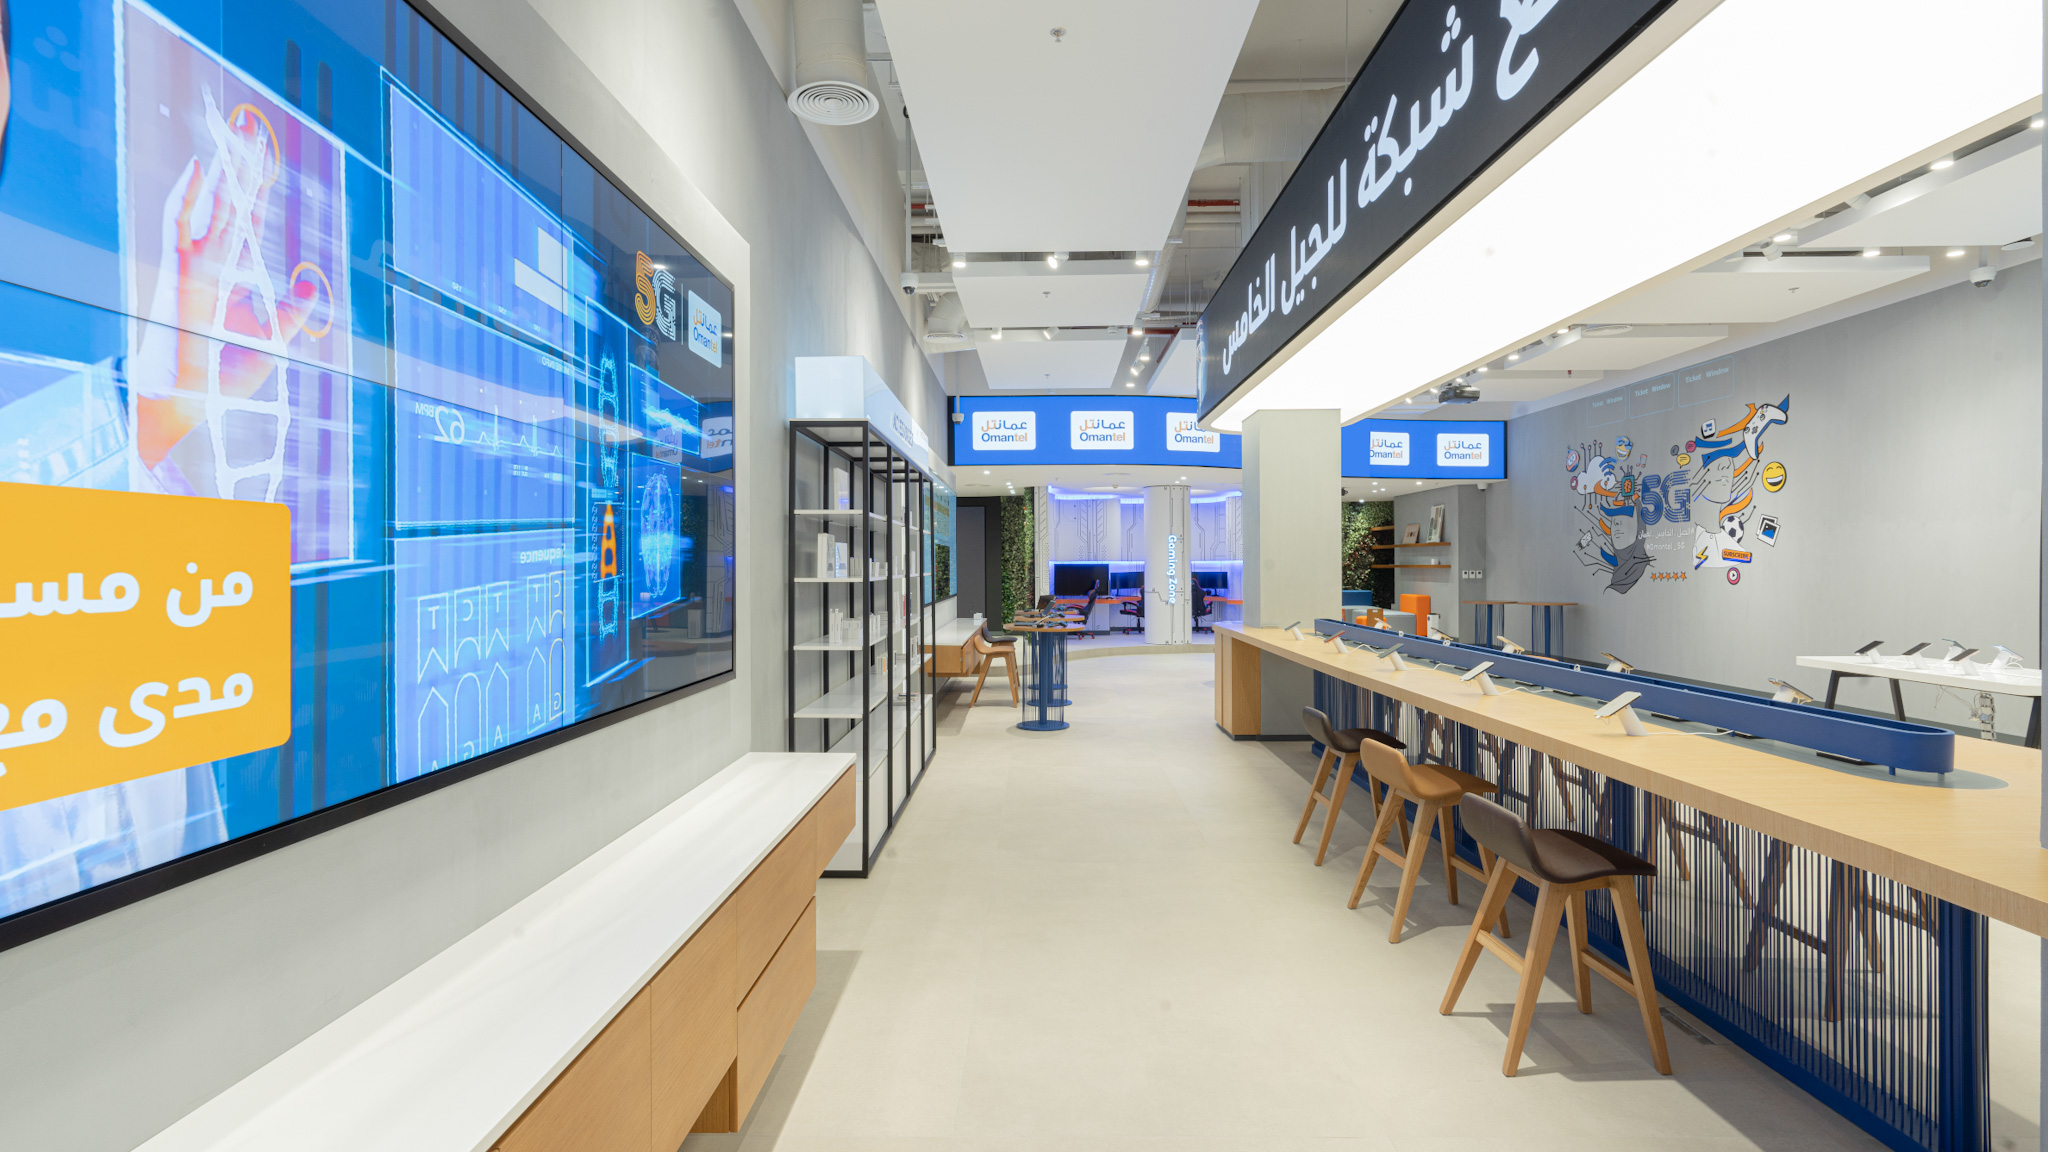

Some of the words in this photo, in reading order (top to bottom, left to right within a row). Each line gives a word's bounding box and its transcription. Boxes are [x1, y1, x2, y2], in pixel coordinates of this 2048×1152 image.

[1357, 5, 1474, 209] شبكة
[1280, 158, 1347, 316] للجيل
[634, 250, 677, 341] 5G
[693, 308, 718, 336] عمانتل
[1222, 253, 1276, 375] الخامس
[693, 327, 718, 355] Omantel
[1685, 374, 1702, 384] Ticket
[1705, 366, 1730, 378] Window
[1634, 388, 1649, 397] Ticket
[1651, 383, 1671, 393] Window
[981, 419, 1028, 432] عمانتل
[981, 432, 1028, 443] Omantel
[1079, 419, 1126, 432] عمانتل
[1079, 431, 1126, 442] Omantel
[1174, 420, 1206, 433] انتل
[1174, 433, 1214, 445] Omantel
[1443, 440, 1482, 451] عمانتل
[1443, 451, 1482, 460] Omantel
[1640, 470, 1691, 526] 5G
[1167, 534, 1178, 576] Gaming
[1723, 550, 1750, 560] SUBSCRIBE
[0, 572, 140, 617] مس
[166, 562, 253, 627] من
[1168, 578, 1178, 605] Zone
[98, 672, 253, 748] مدى
